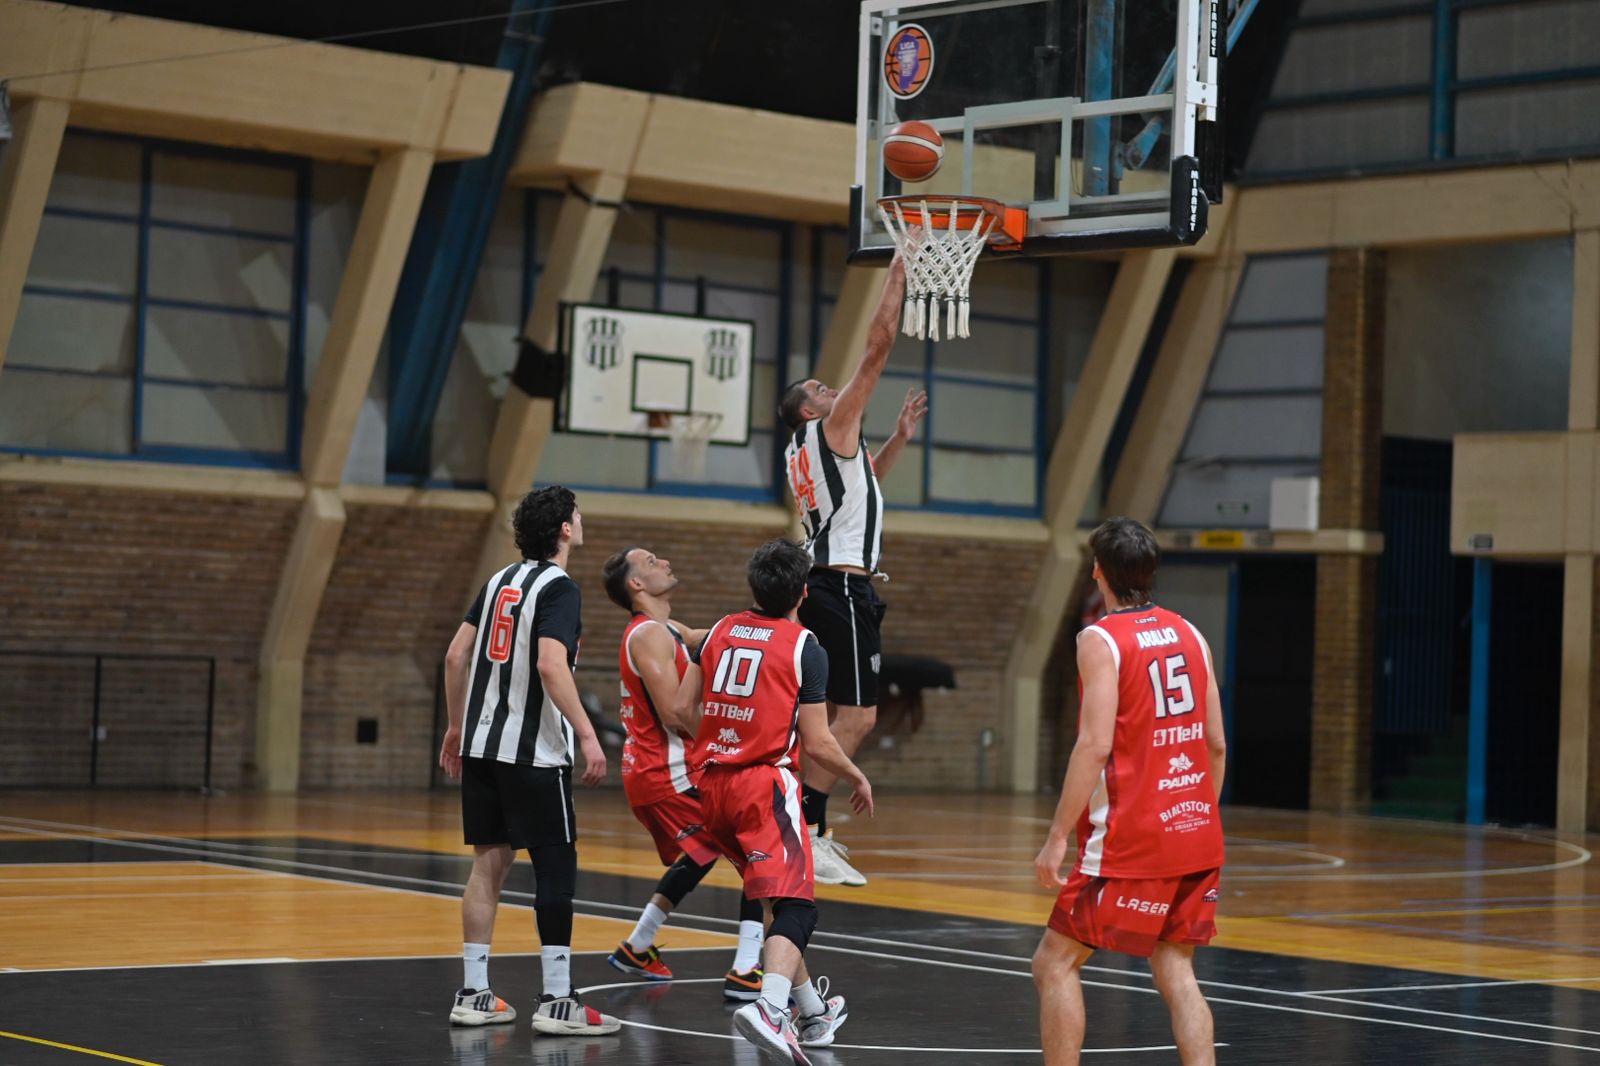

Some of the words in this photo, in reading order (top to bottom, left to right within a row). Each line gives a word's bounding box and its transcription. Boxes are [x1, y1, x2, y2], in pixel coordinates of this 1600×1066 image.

[486, 585, 522, 663] 6
[728, 624, 774, 642] BOGLIONE
[1135, 626, 1179, 649] ARAUJO
[711, 646, 764, 698] 10
[1147, 653, 1196, 719] 15
[1158, 771, 1206, 791] PAUNY
[1116, 896, 1170, 914] LASER
